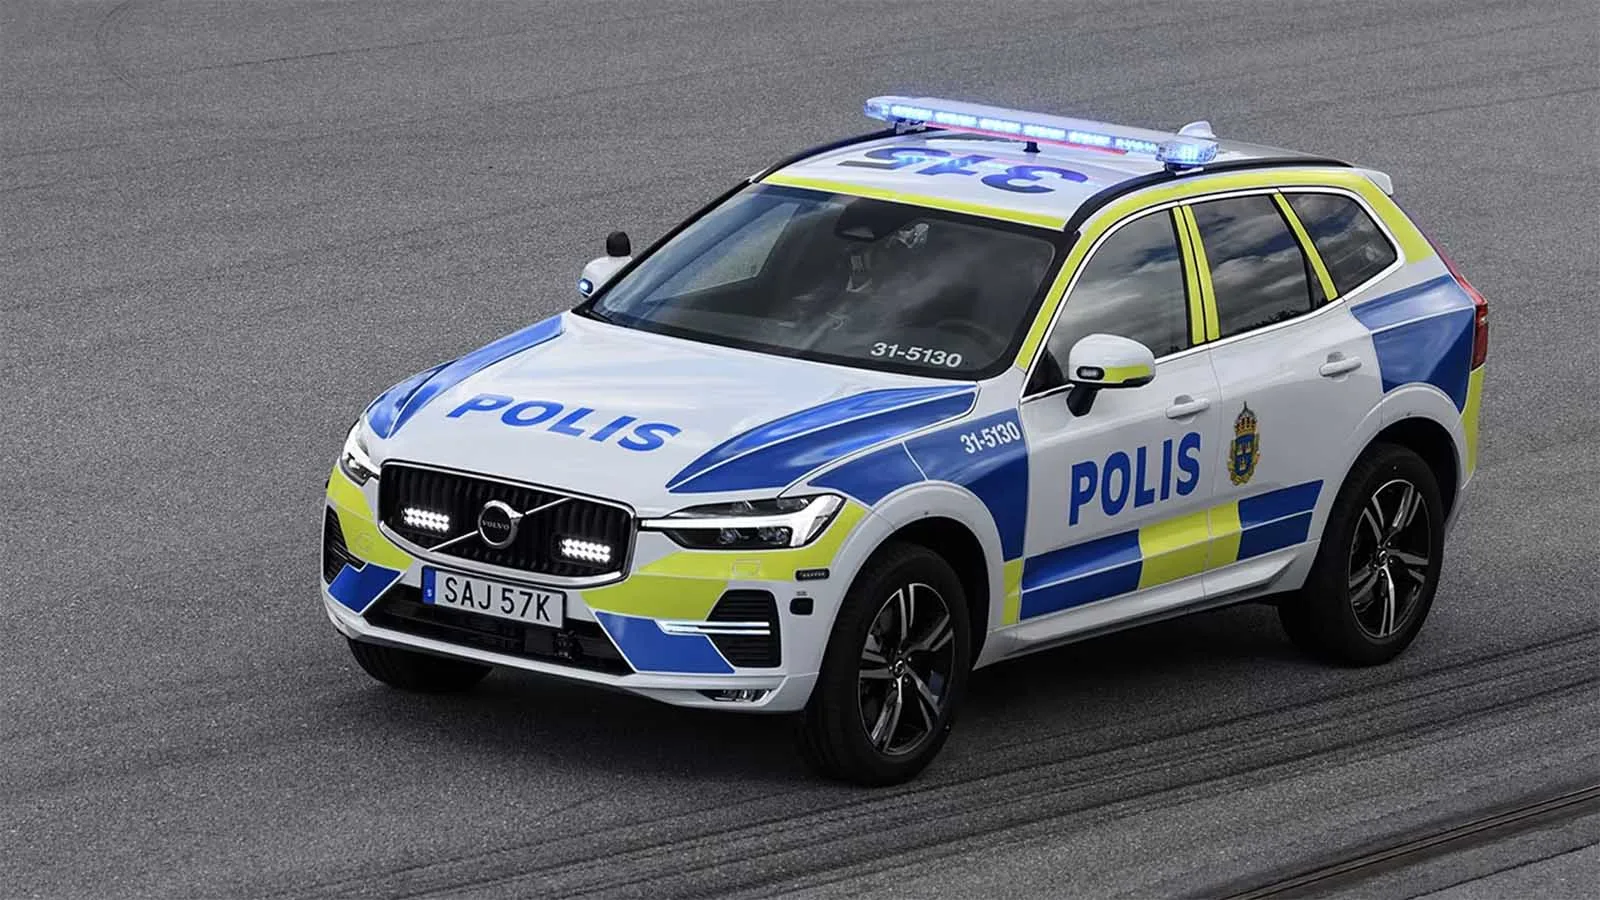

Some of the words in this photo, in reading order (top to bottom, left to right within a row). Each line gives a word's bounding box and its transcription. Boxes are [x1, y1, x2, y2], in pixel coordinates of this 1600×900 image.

[837, 147, 1089, 194] 315
[870, 342, 963, 368] 31-5130
[446, 392, 682, 451] POLIS
[960, 421, 1021, 454] 31-5130
[1069, 431, 1202, 526] POLIS
[482, 519, 510, 530] VOLVO
[444, 576, 492, 610] SAJ
[500, 588, 551, 623] 57K
